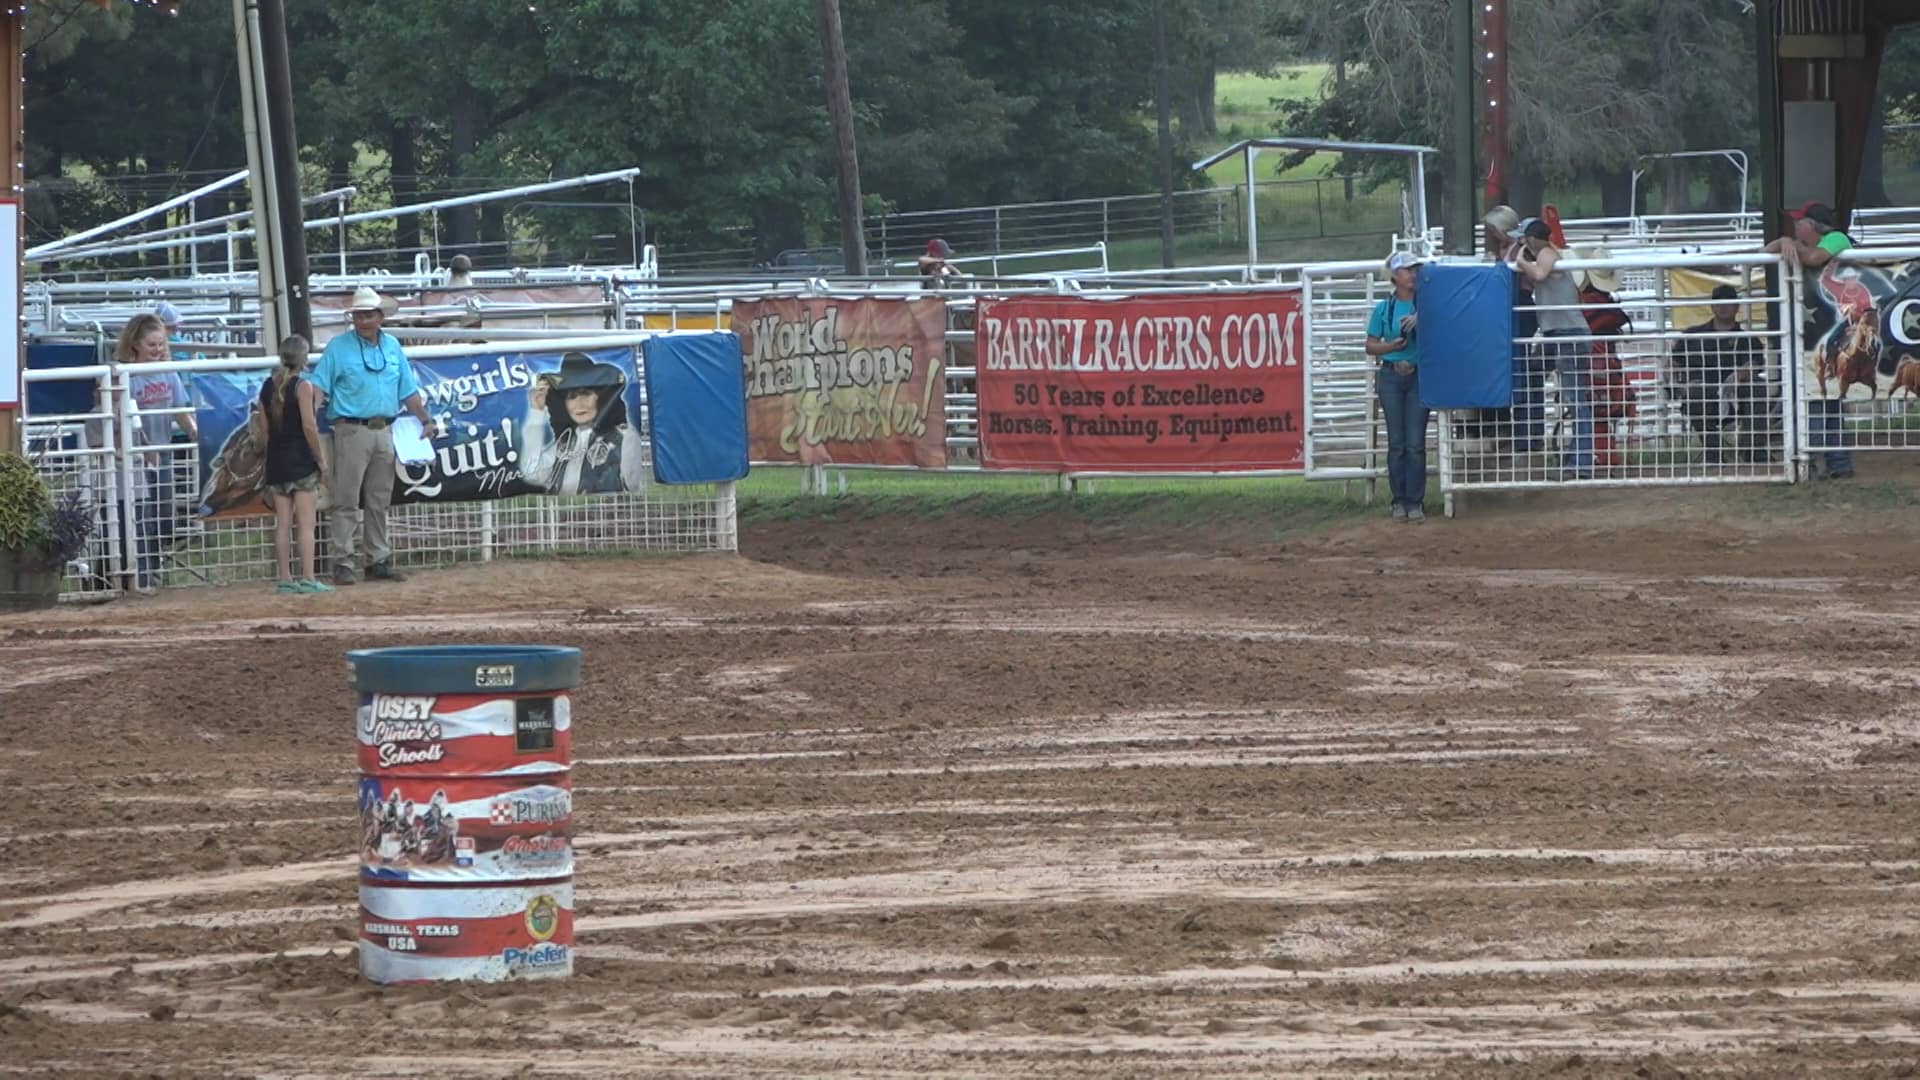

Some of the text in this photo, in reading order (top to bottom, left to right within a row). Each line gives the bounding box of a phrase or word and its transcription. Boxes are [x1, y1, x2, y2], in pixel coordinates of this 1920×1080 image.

[750, 306, 836, 361] World
[985, 311, 1298, 373] BARRELRACERS.COM
[415, 355, 529, 412] wgirls
[1013, 383, 1266, 407] 50 Years of Excellence
[364, 693, 436, 732] JOSEY
[378, 742, 444, 768] Schools
[387, 936, 417, 951] USA
[415, 924, 459, 937] TEXAS
